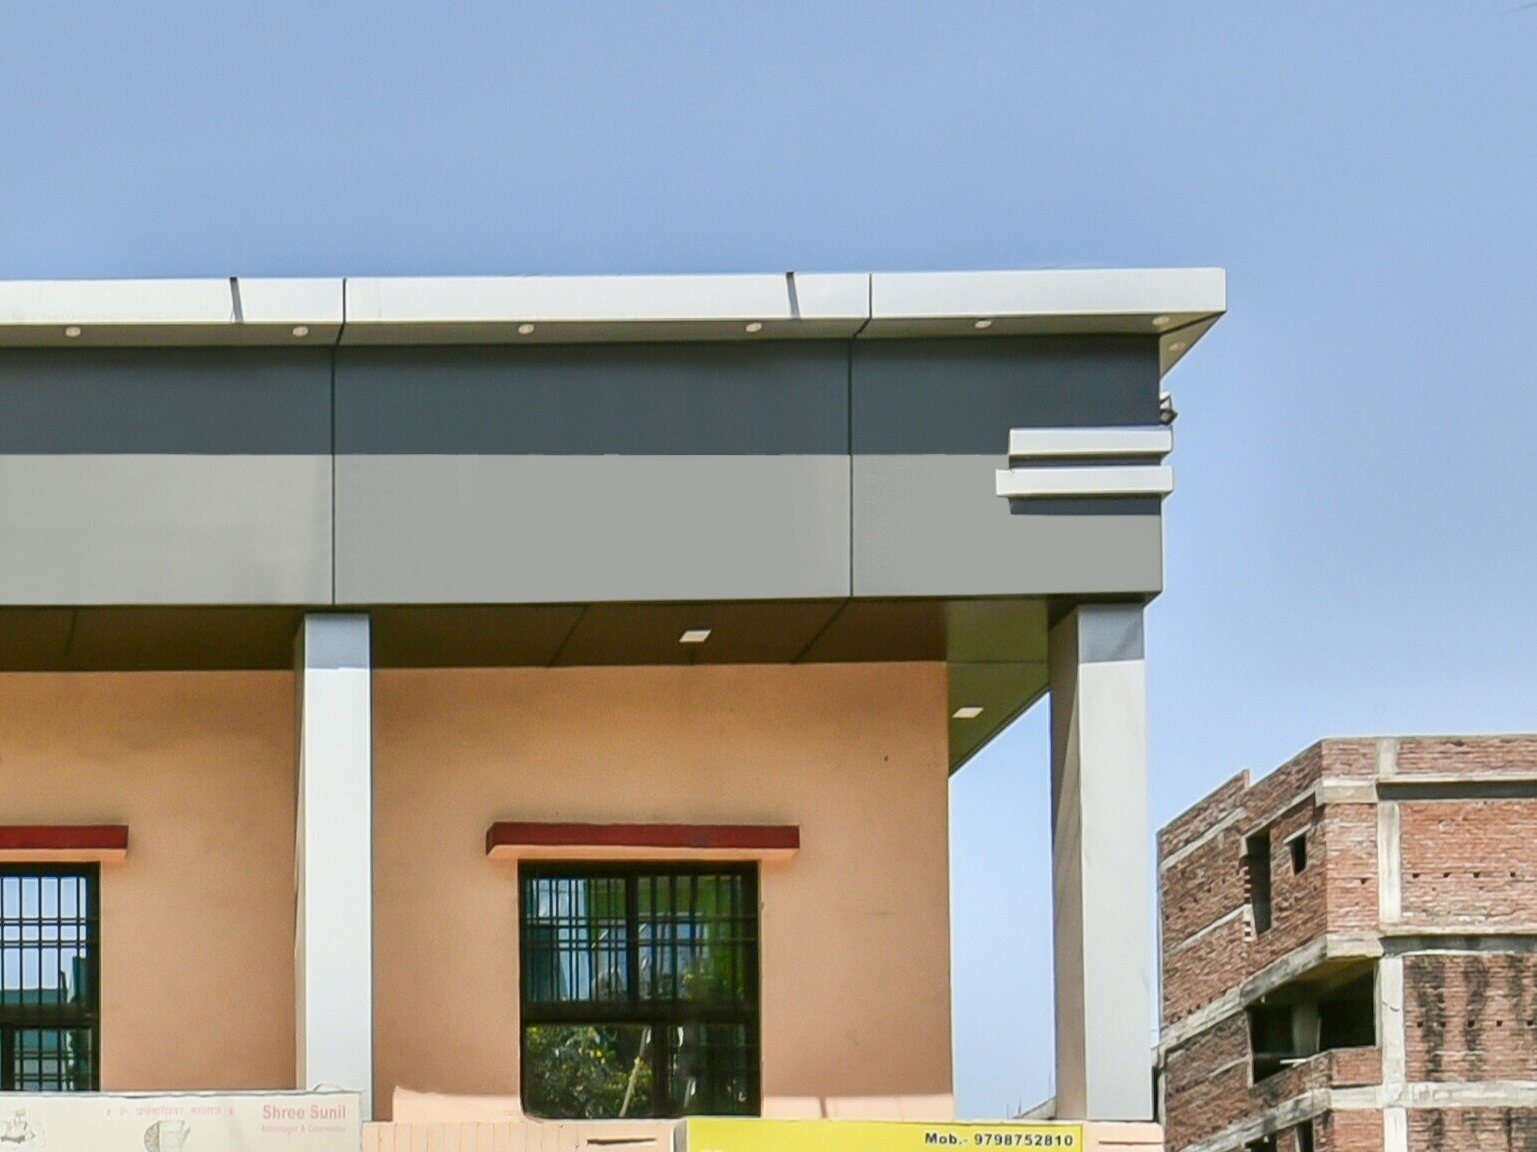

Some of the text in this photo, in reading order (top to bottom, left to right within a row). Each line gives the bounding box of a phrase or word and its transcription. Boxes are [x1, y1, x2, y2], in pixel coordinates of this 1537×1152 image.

[262, 1103, 347, 1120] Shree Sunil
[973, 1132, 1074, 1148] 9798752810
